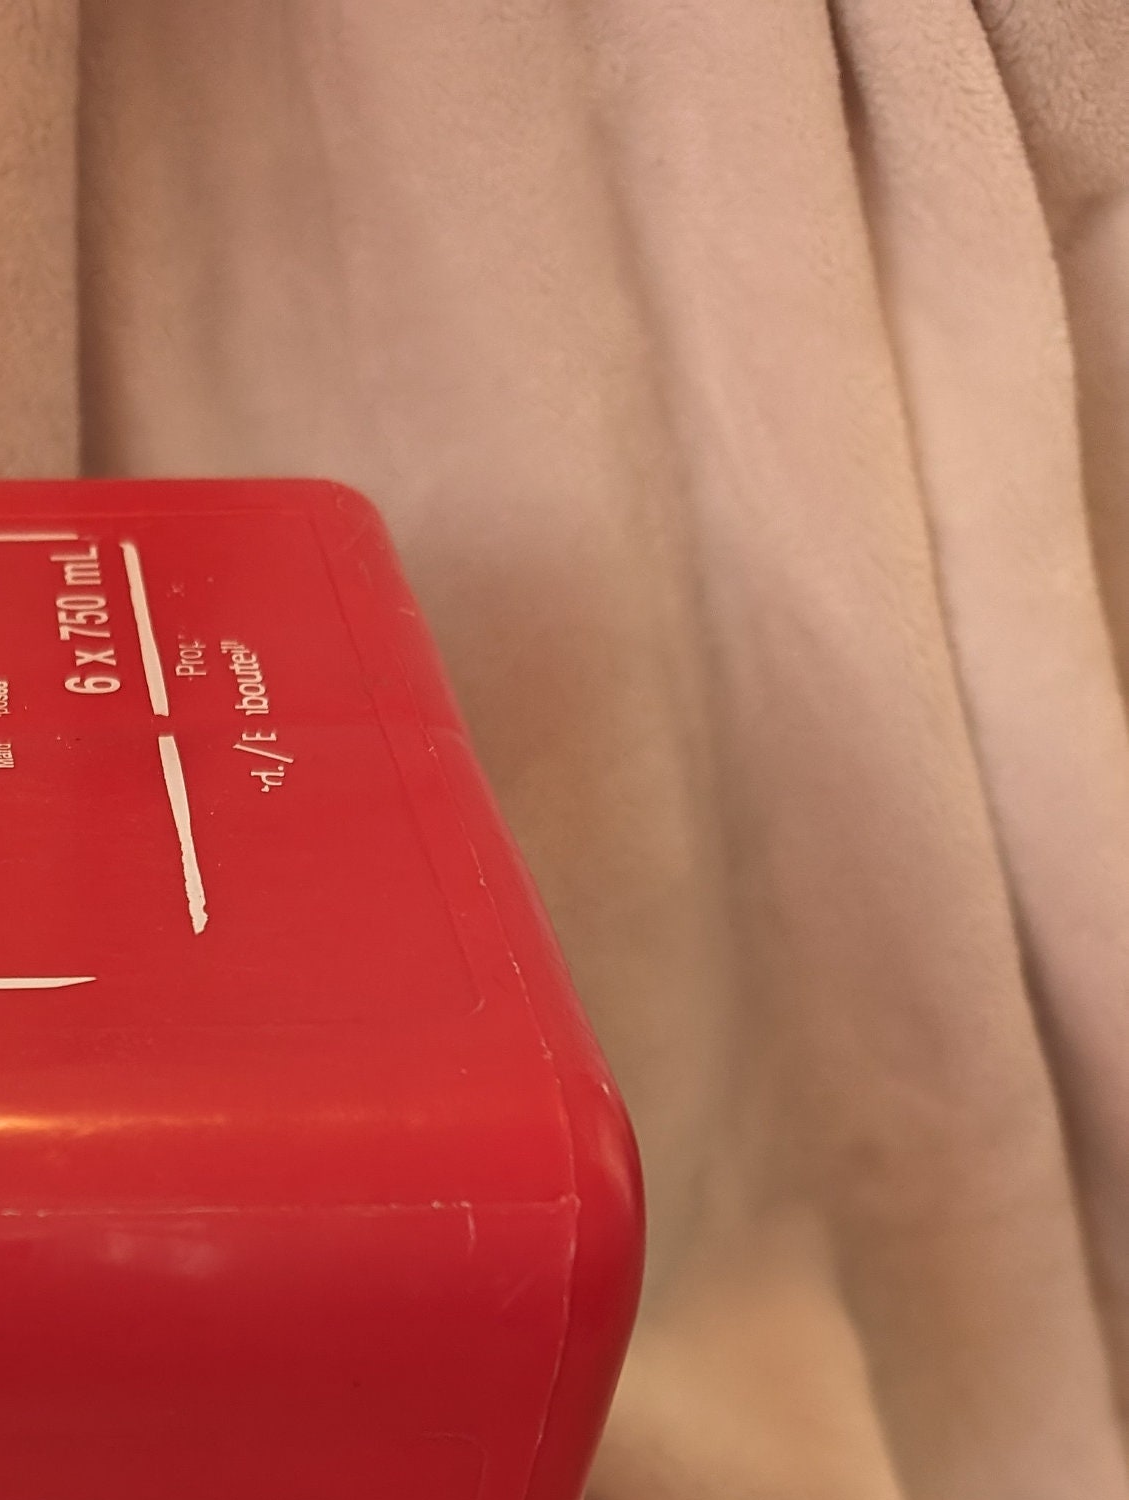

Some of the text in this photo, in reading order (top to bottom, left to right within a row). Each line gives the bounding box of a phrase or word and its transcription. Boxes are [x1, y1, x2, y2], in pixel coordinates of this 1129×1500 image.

[50, 544, 121, 695] 6 x 750 mL
